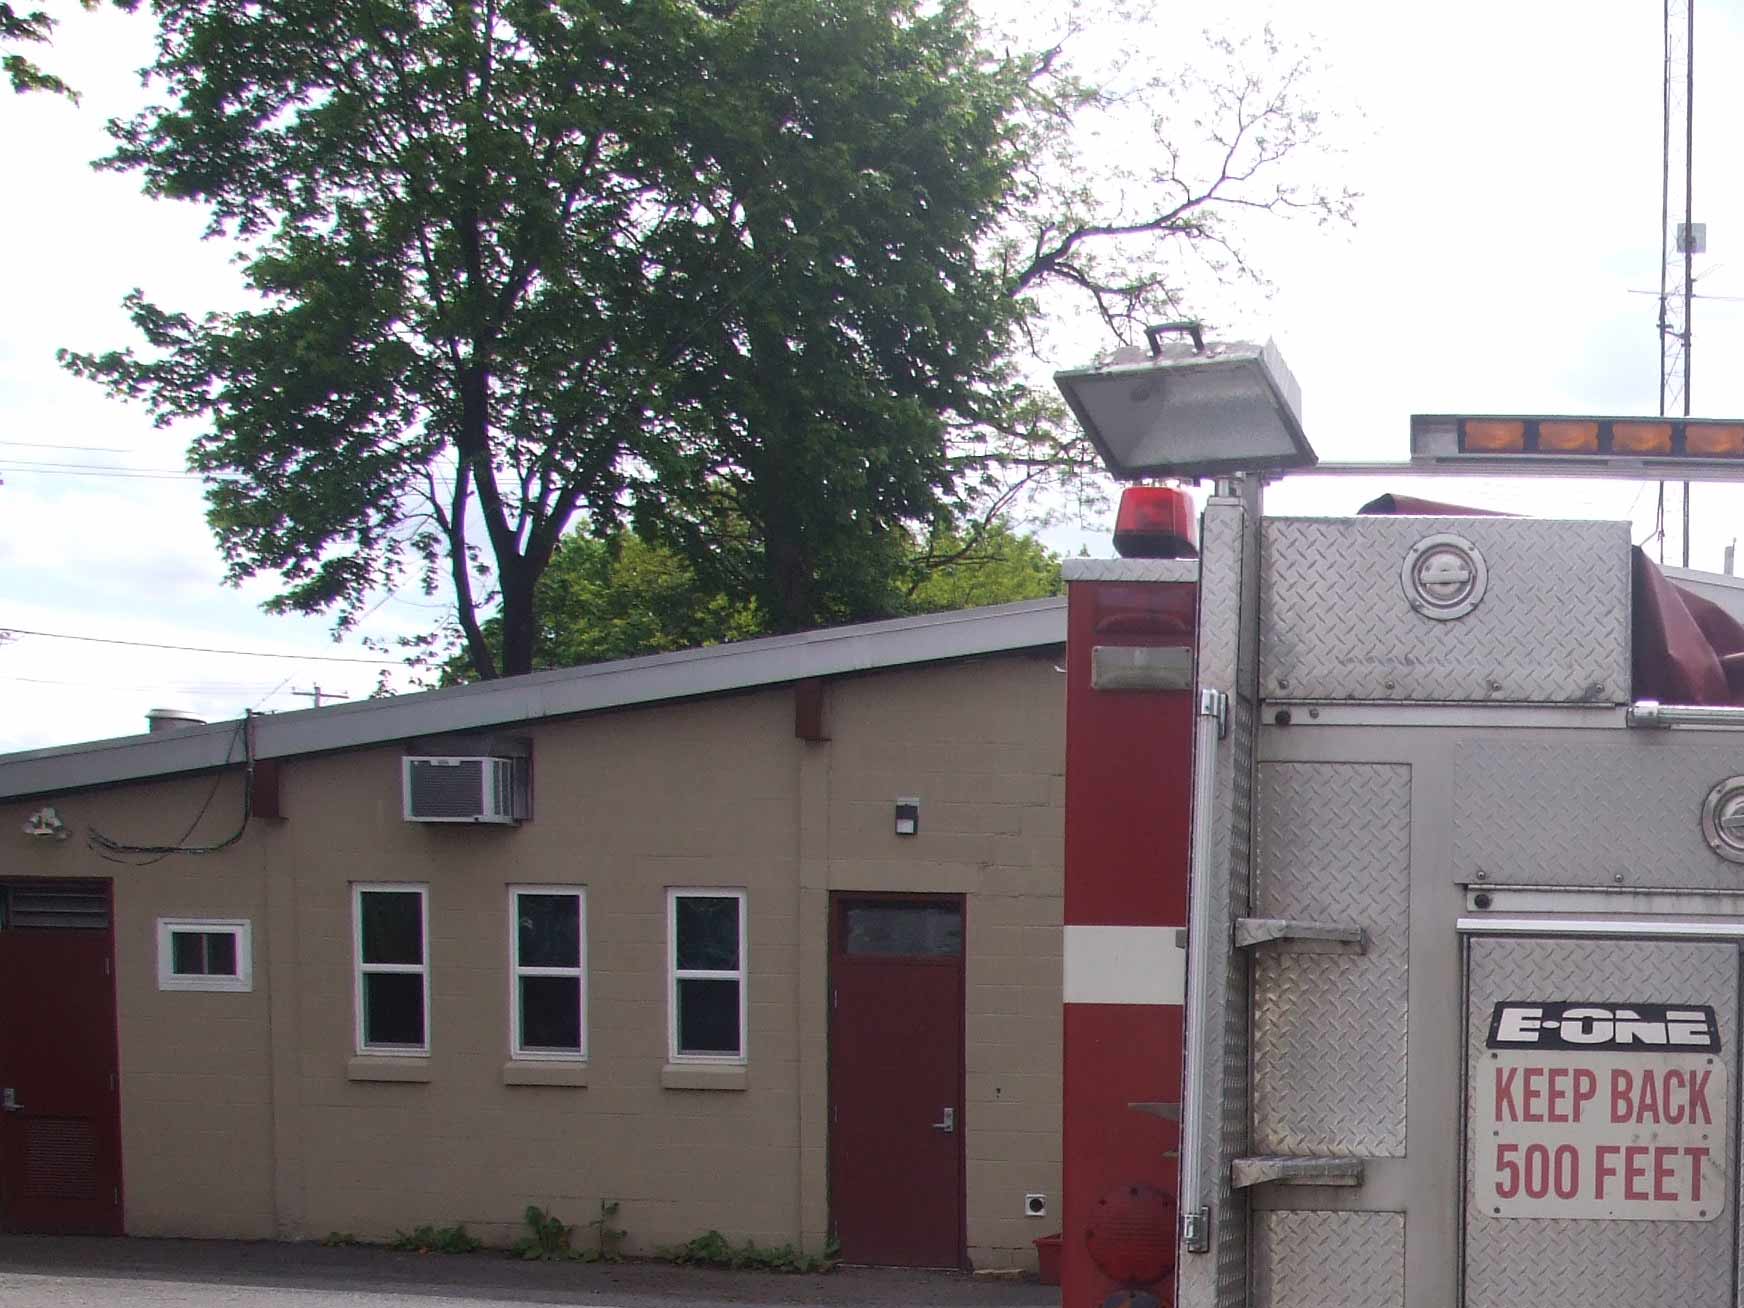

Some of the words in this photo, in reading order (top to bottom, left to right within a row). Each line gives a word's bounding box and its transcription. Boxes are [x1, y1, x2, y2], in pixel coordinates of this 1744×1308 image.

[1495, 1067, 1597, 1122] KEEP
[1610, 1069, 1712, 1125] BACK
[1495, 1144, 1579, 1199] 500
[1595, 1145, 1710, 1201] FEET
